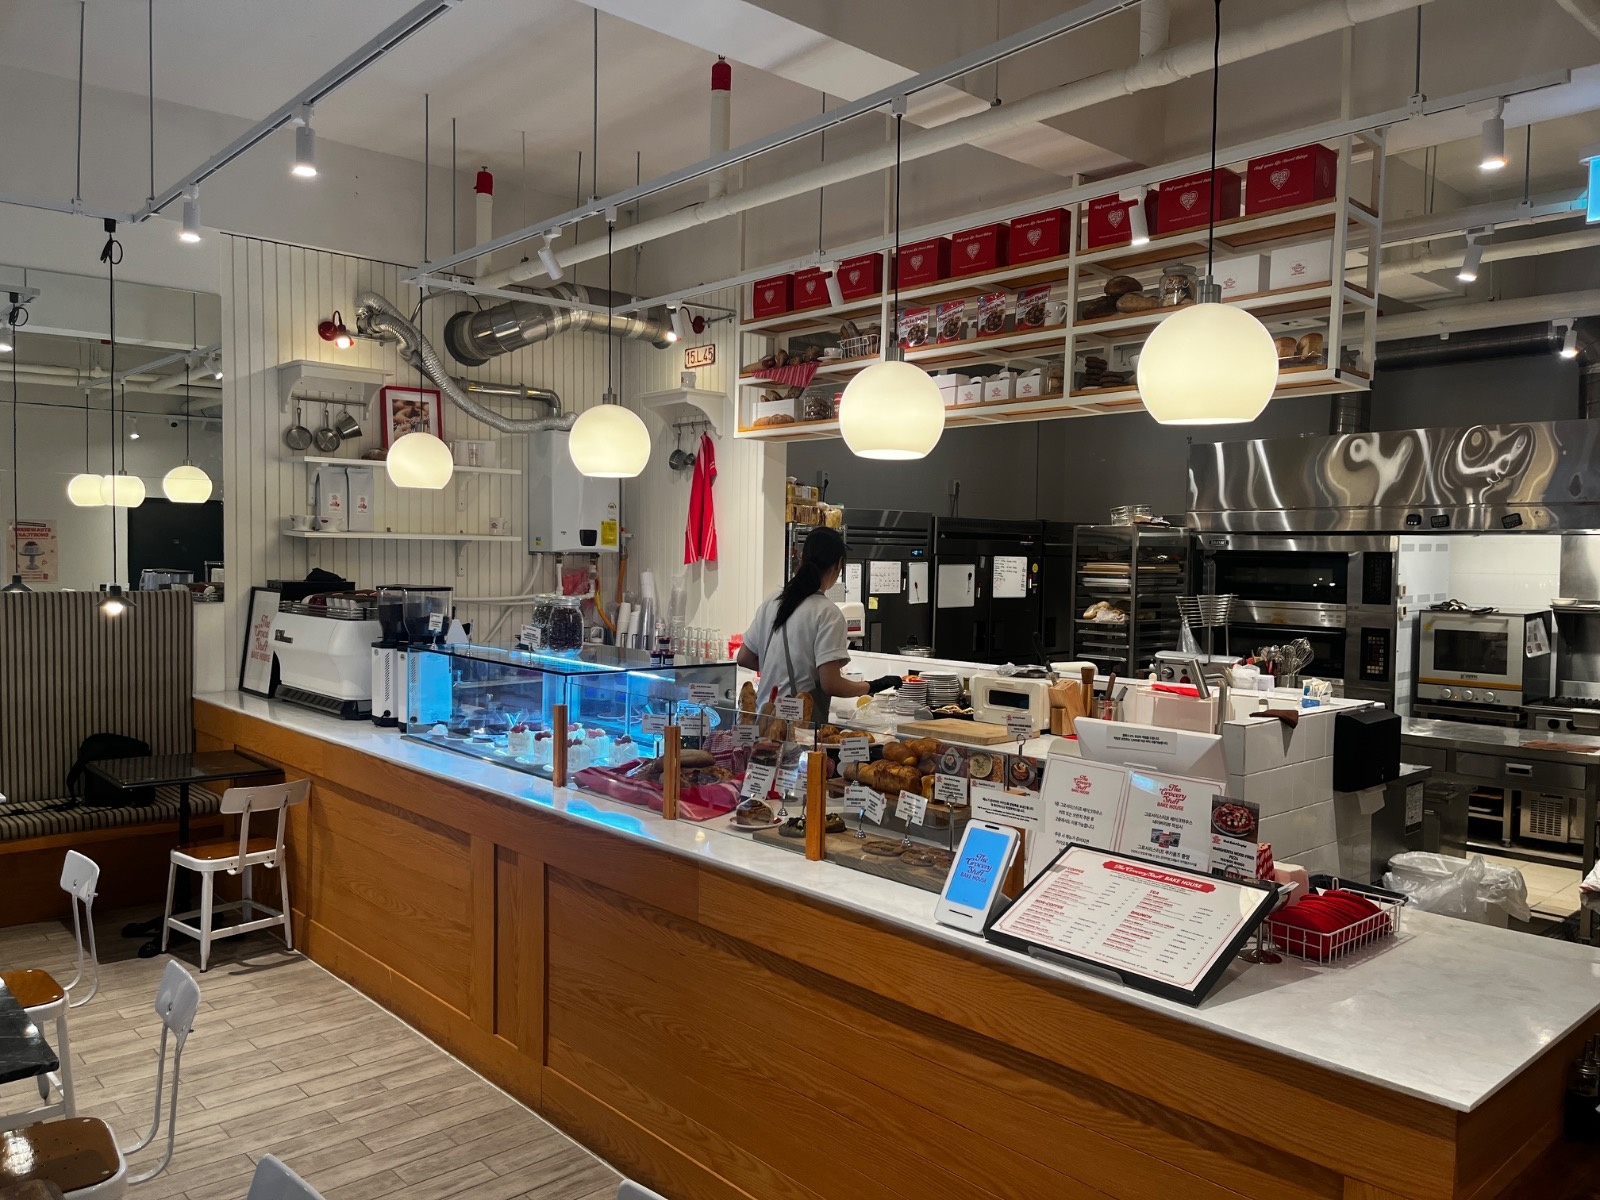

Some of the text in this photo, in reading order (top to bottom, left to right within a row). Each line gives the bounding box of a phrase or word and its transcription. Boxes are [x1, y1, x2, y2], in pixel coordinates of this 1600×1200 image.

[1169, 784, 1181, 792] The
[976, 854, 989, 863] The
[966, 858, 992, 873] Grocery
[968, 866, 986, 876] Stuff
[1164, 876, 1181, 884] BAKE
[1181, 880, 1203, 889] HOUSE
